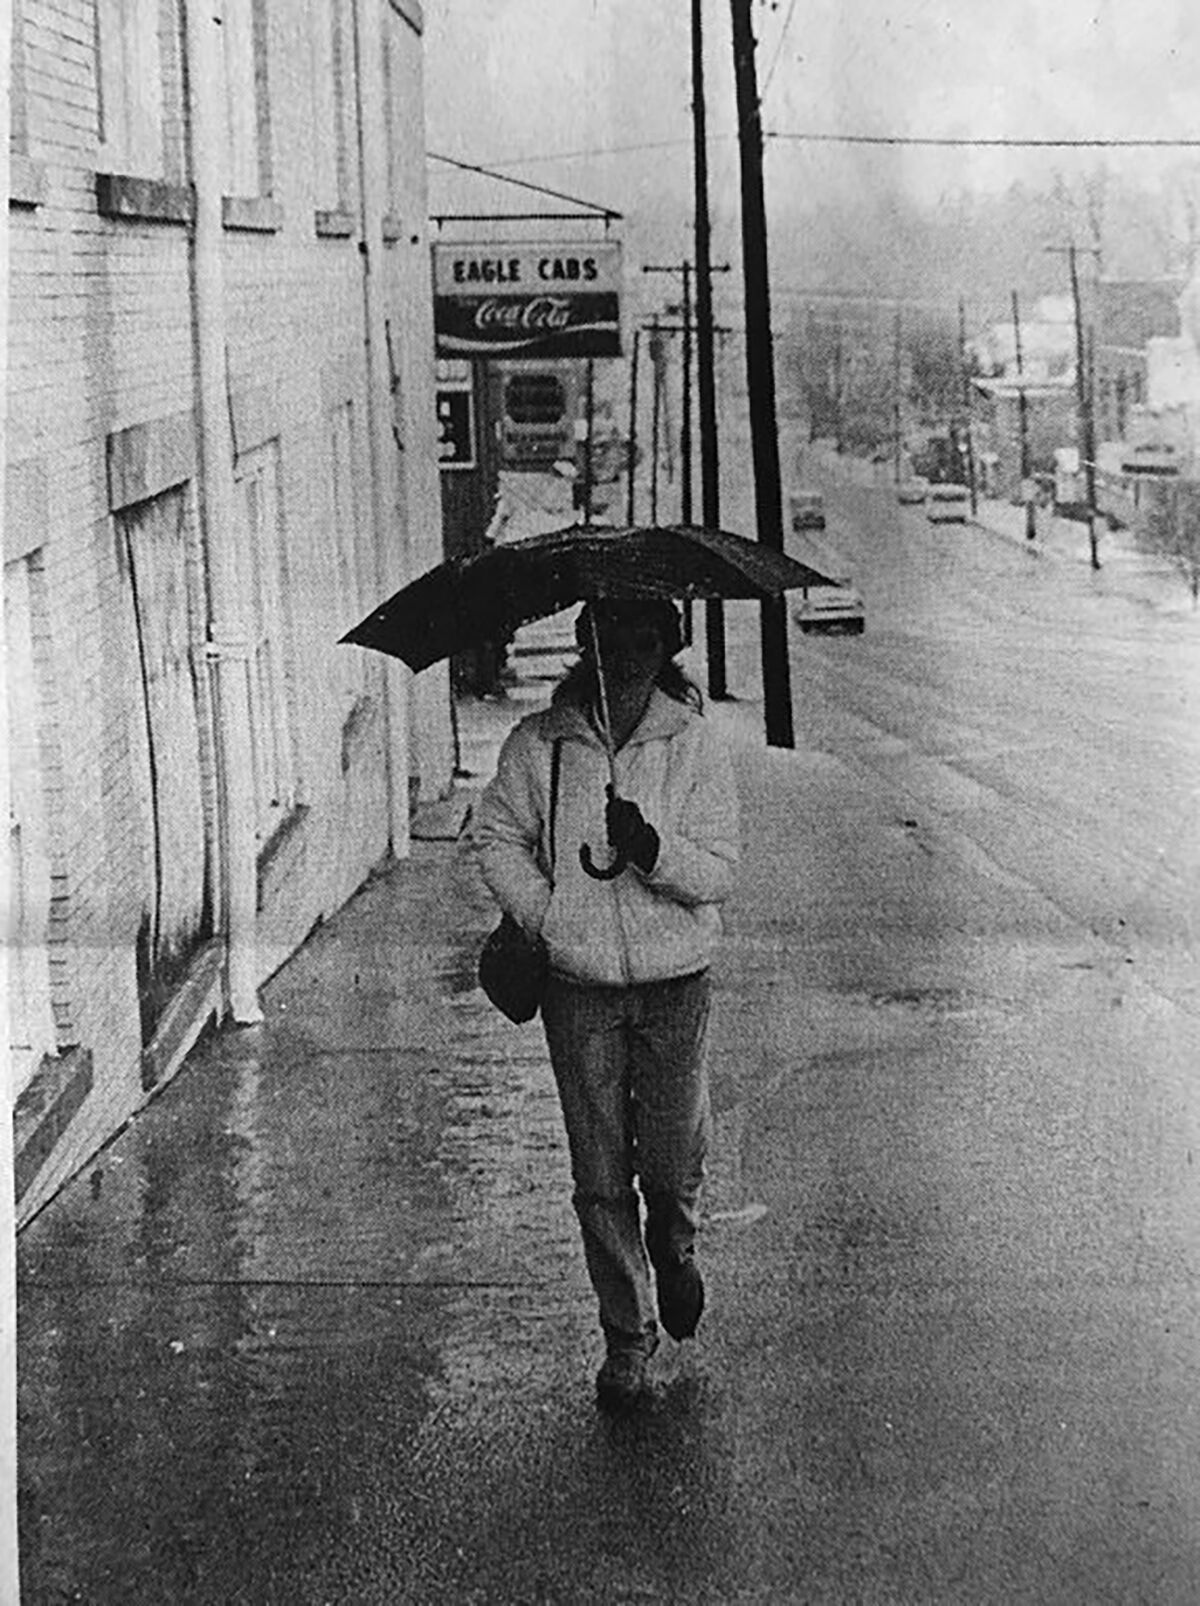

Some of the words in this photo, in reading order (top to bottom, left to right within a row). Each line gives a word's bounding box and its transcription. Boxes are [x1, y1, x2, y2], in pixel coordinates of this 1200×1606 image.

[453, 259, 521, 283] EAGLE
[537, 257, 598, 281] CABS
[474, 296, 572, 330] Coca-Cola
